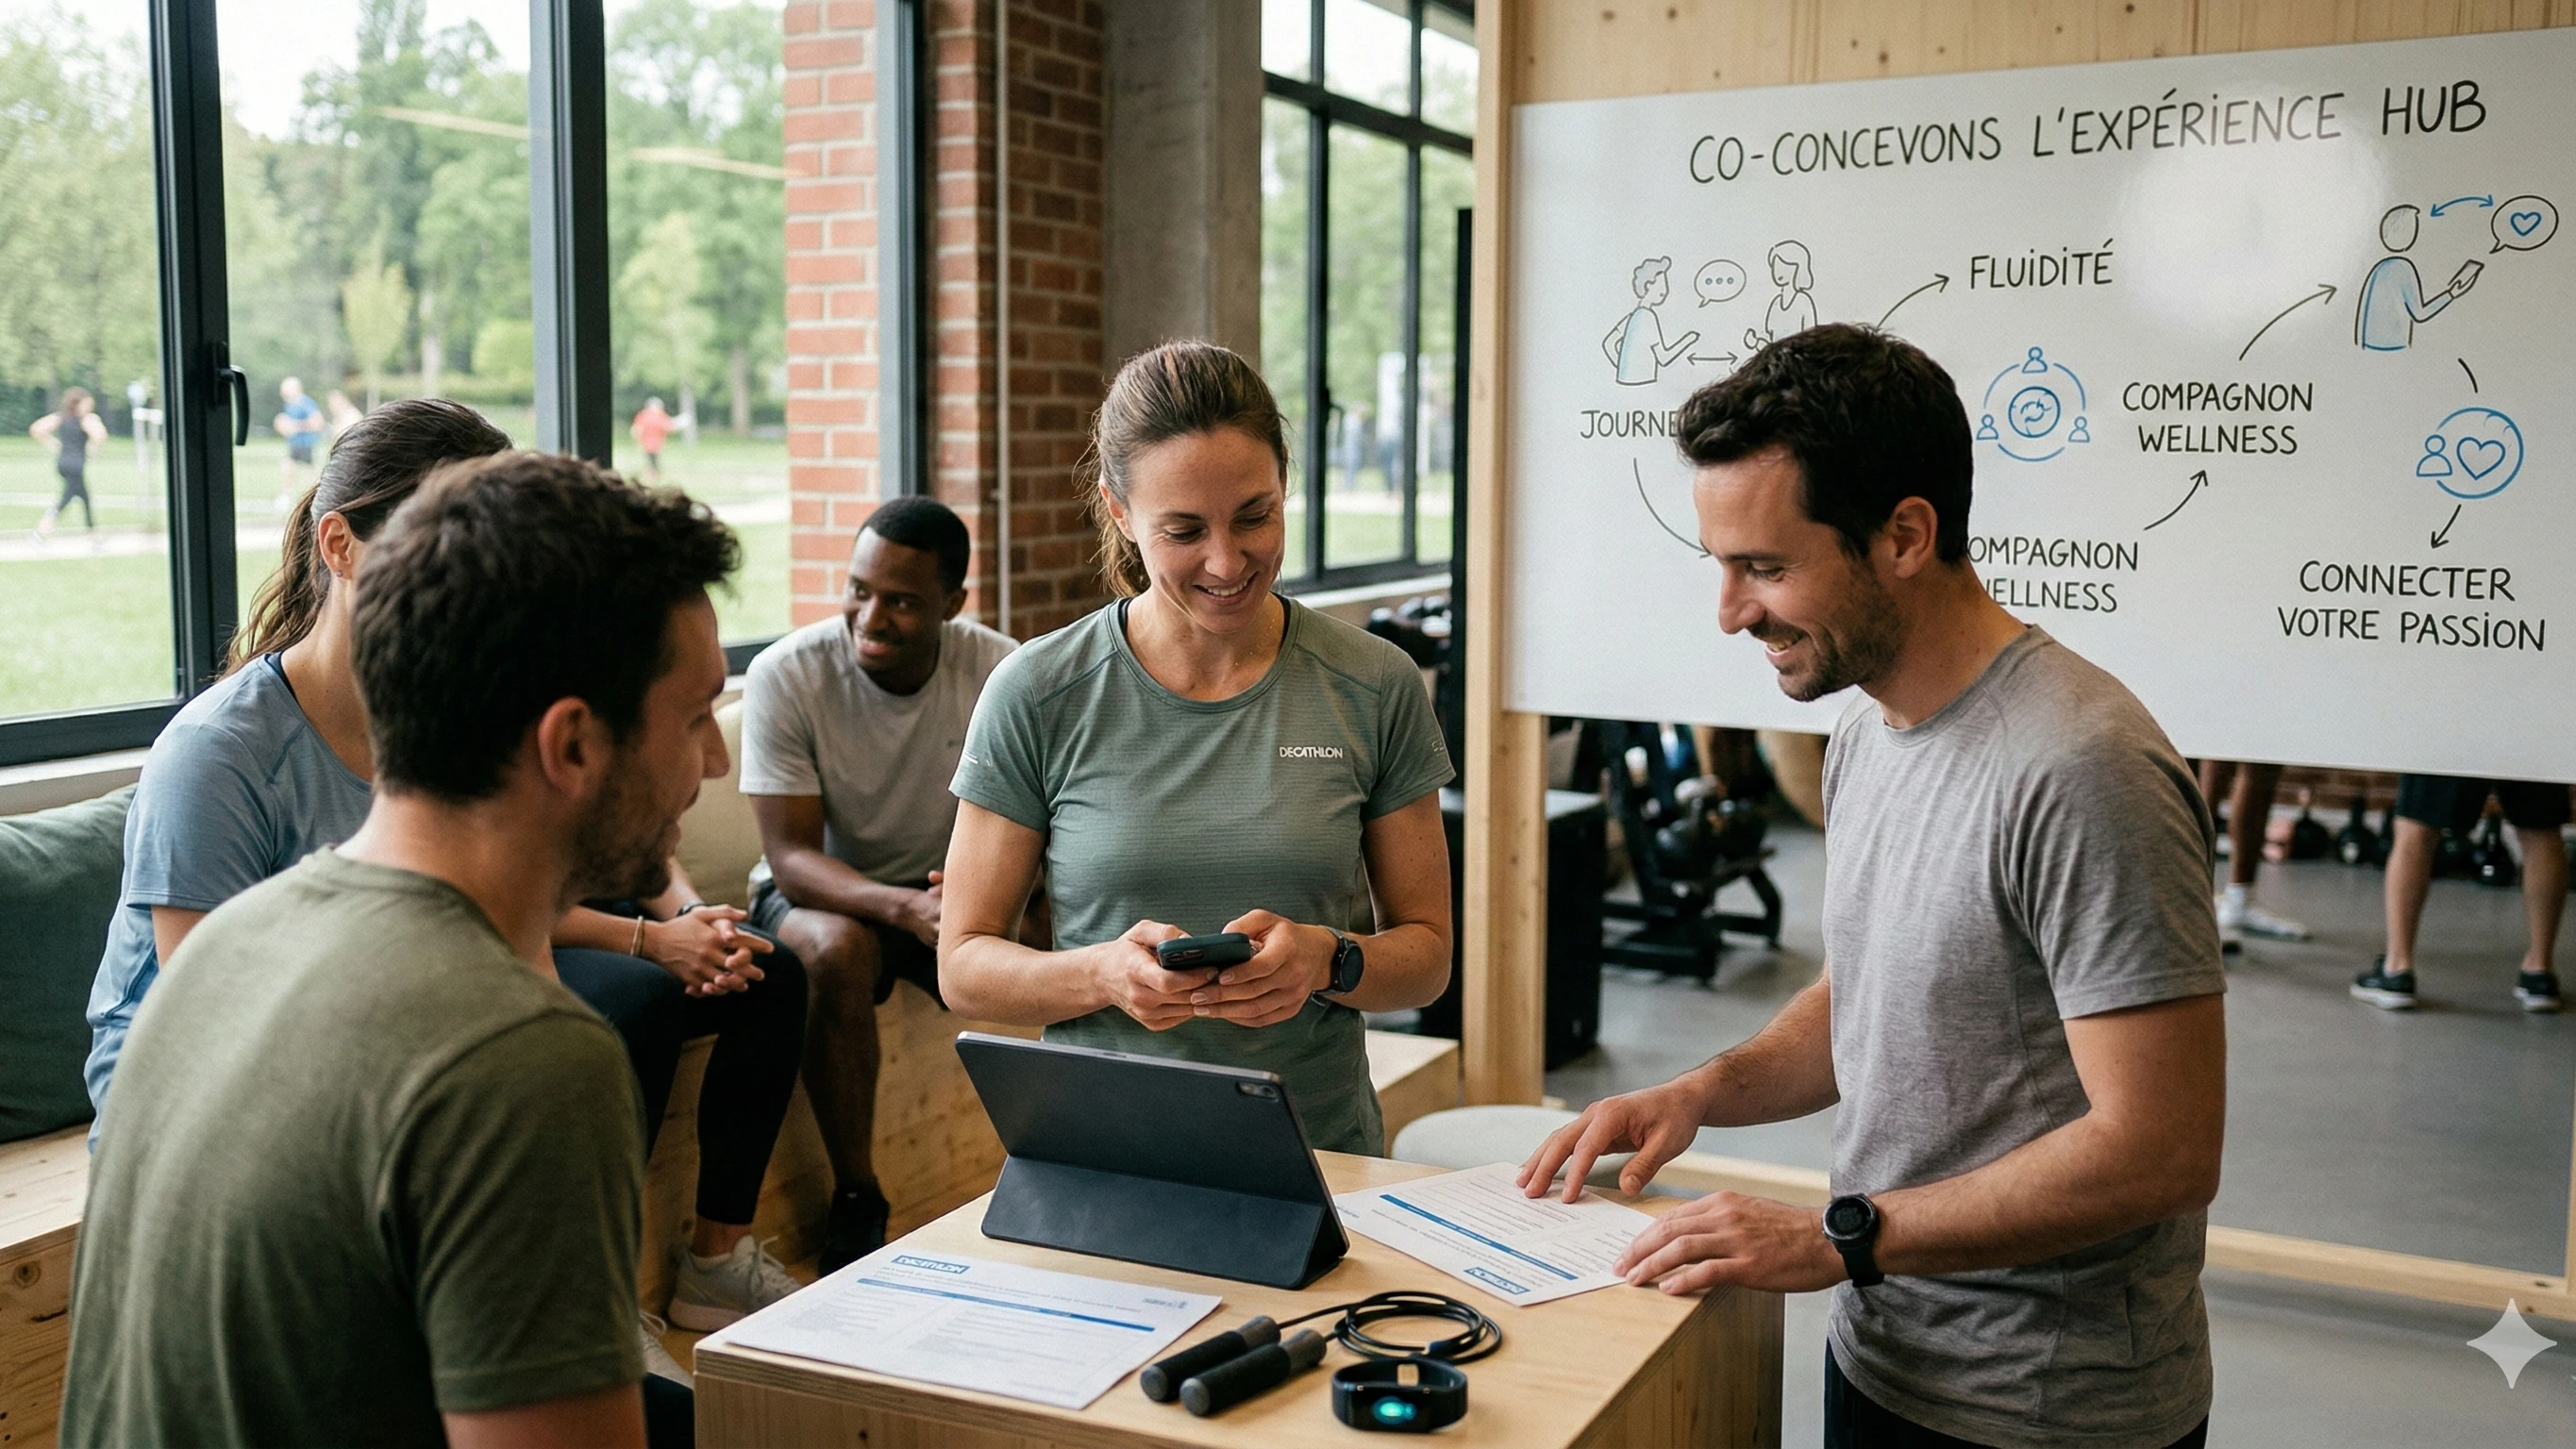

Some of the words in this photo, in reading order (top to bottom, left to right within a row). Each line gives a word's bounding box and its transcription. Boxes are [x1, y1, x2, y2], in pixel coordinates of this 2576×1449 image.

[1688, 115, 2003, 185] CO-CONCEVONS
[2381, 78, 2489, 137] HUB
[2121, 380, 2315, 414] COMPAGNON
[2136, 423, 2300, 457] WELLNESS
[1967, 535, 2139, 573] OMPAGNON
[2298, 558, 2517, 604] CONNECTER
[2276, 605, 2383, 642] VOTRE
[1279, 746, 1344, 758] DECATHLON
